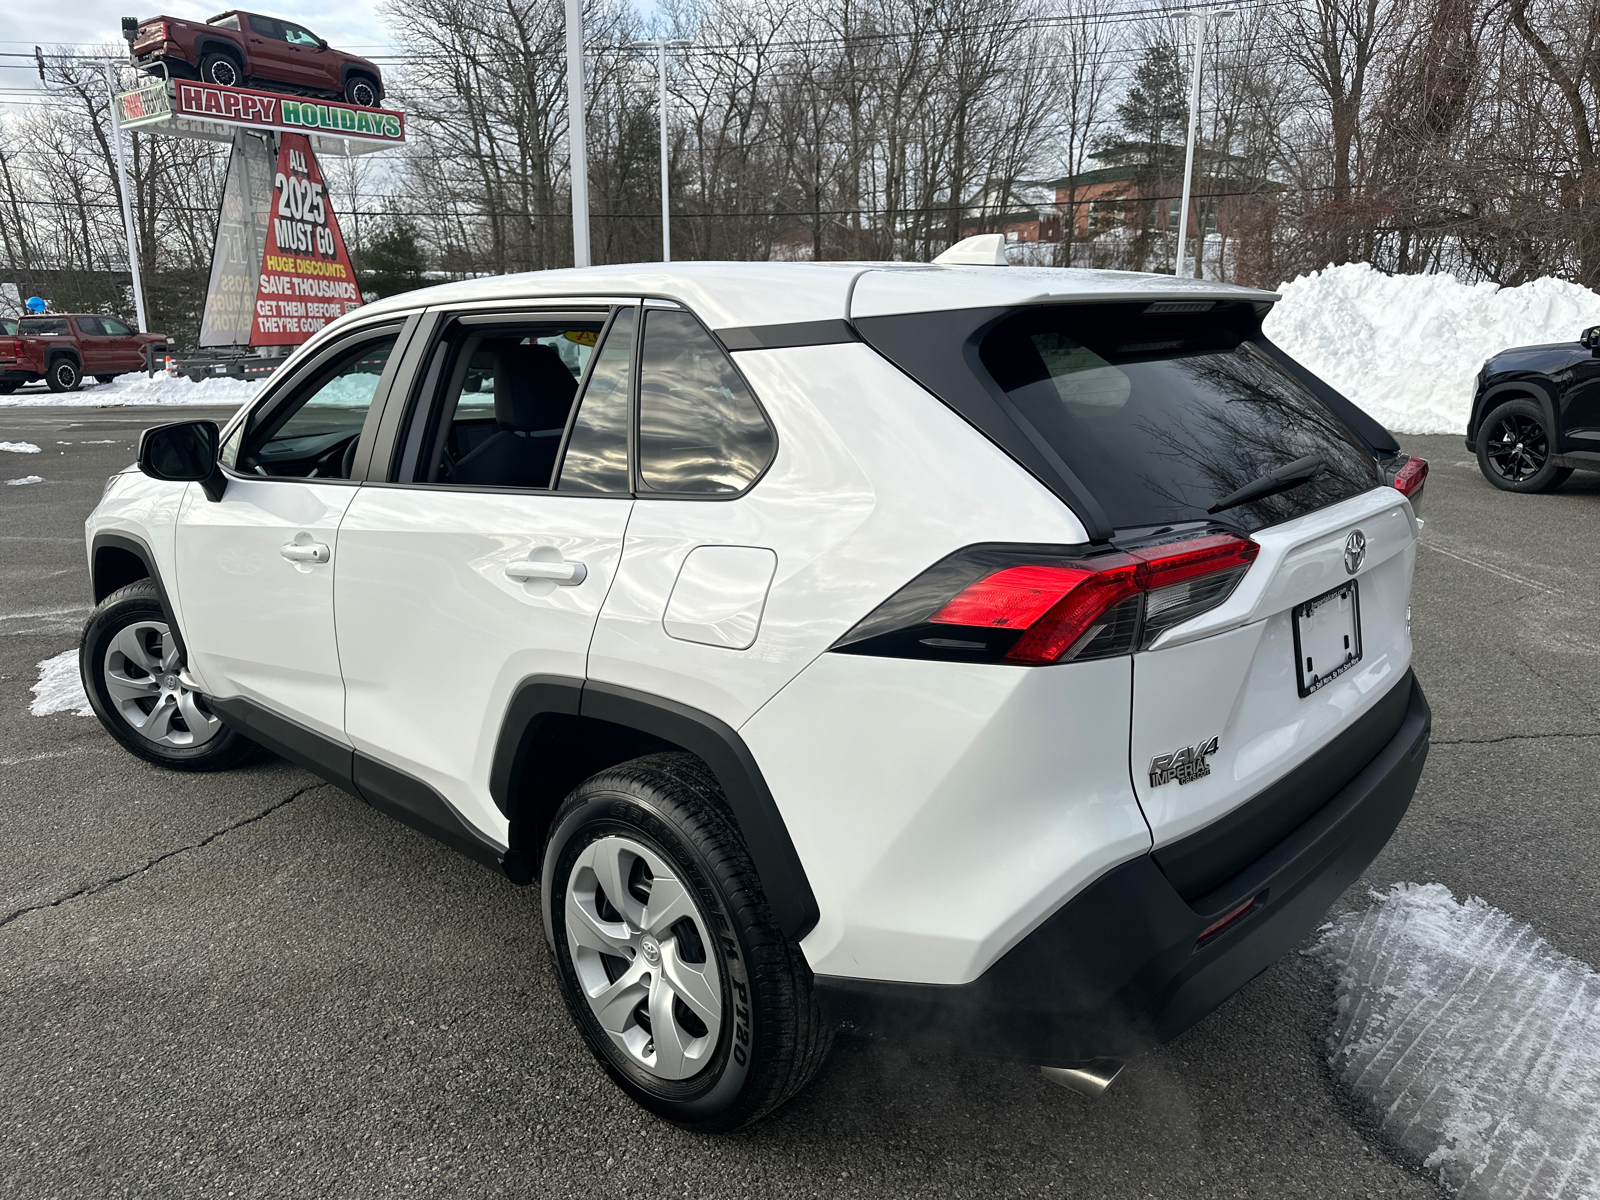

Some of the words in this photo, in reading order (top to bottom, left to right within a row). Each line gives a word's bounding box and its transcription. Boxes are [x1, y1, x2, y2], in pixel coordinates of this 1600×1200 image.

[180, 85, 276, 122] HAPPY
[280, 100, 401, 138] HOLIDAYS
[289, 149, 308, 174] ALL
[275, 172, 325, 224] 2025
[274, 218, 313, 252] MUST
[316, 226, 334, 255] GO
[266, 255, 296, 273] HUGE
[296, 258, 347, 278] DISCOUNTS
[260, 274, 292, 295] SAVE
[292, 277, 357, 300] THOUSANDS
[256, 300, 277, 316] GET
[278, 301, 305, 317] THEM
[307, 303, 342, 318] BEFORE
[258, 317, 299, 333] THEY'RE
[300, 318, 326, 333] GONE
[1148, 734, 1219, 776] RAV4
[1150, 757, 1210, 787] IMPERIAL
[1179, 771, 1211, 785] cars.com
[731, 975, 751, 1067] PT20
